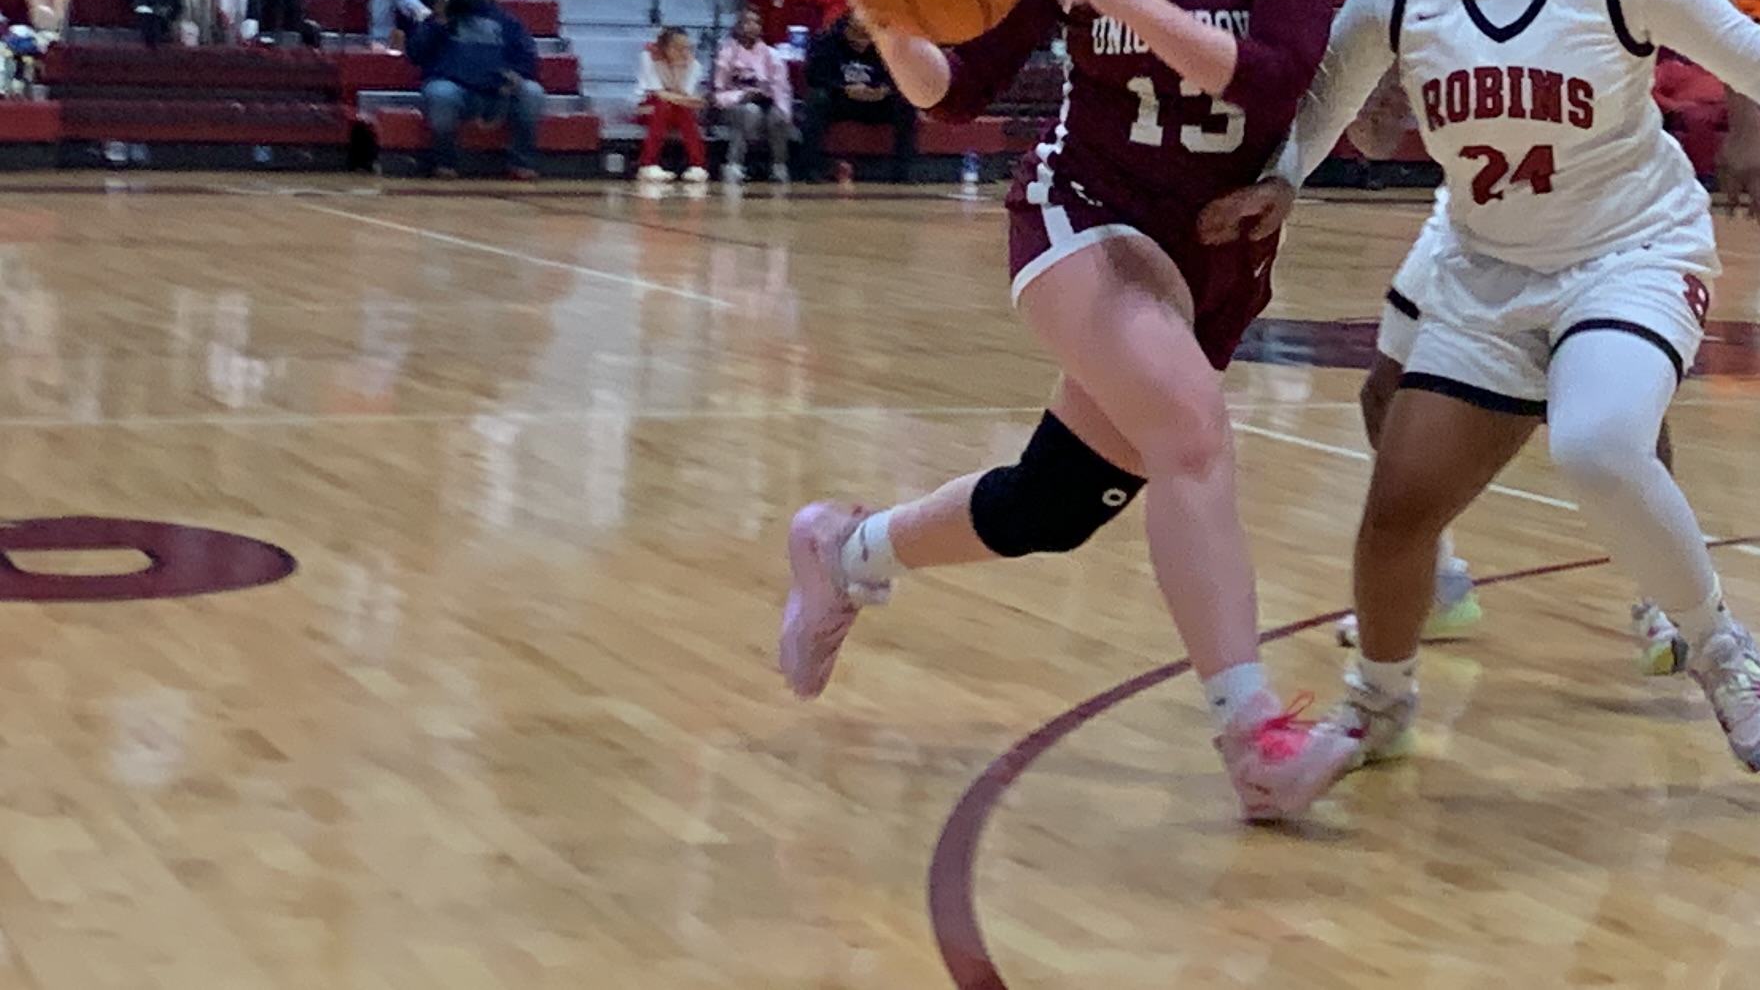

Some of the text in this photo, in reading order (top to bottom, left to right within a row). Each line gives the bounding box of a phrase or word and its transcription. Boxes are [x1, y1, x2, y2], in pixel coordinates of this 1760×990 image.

[1092, 15, 1152, 55] UNIO
[1126, 76, 1247, 153] 13
[1422, 65, 1594, 132] ROBINS
[1458, 144, 1556, 206] 24
